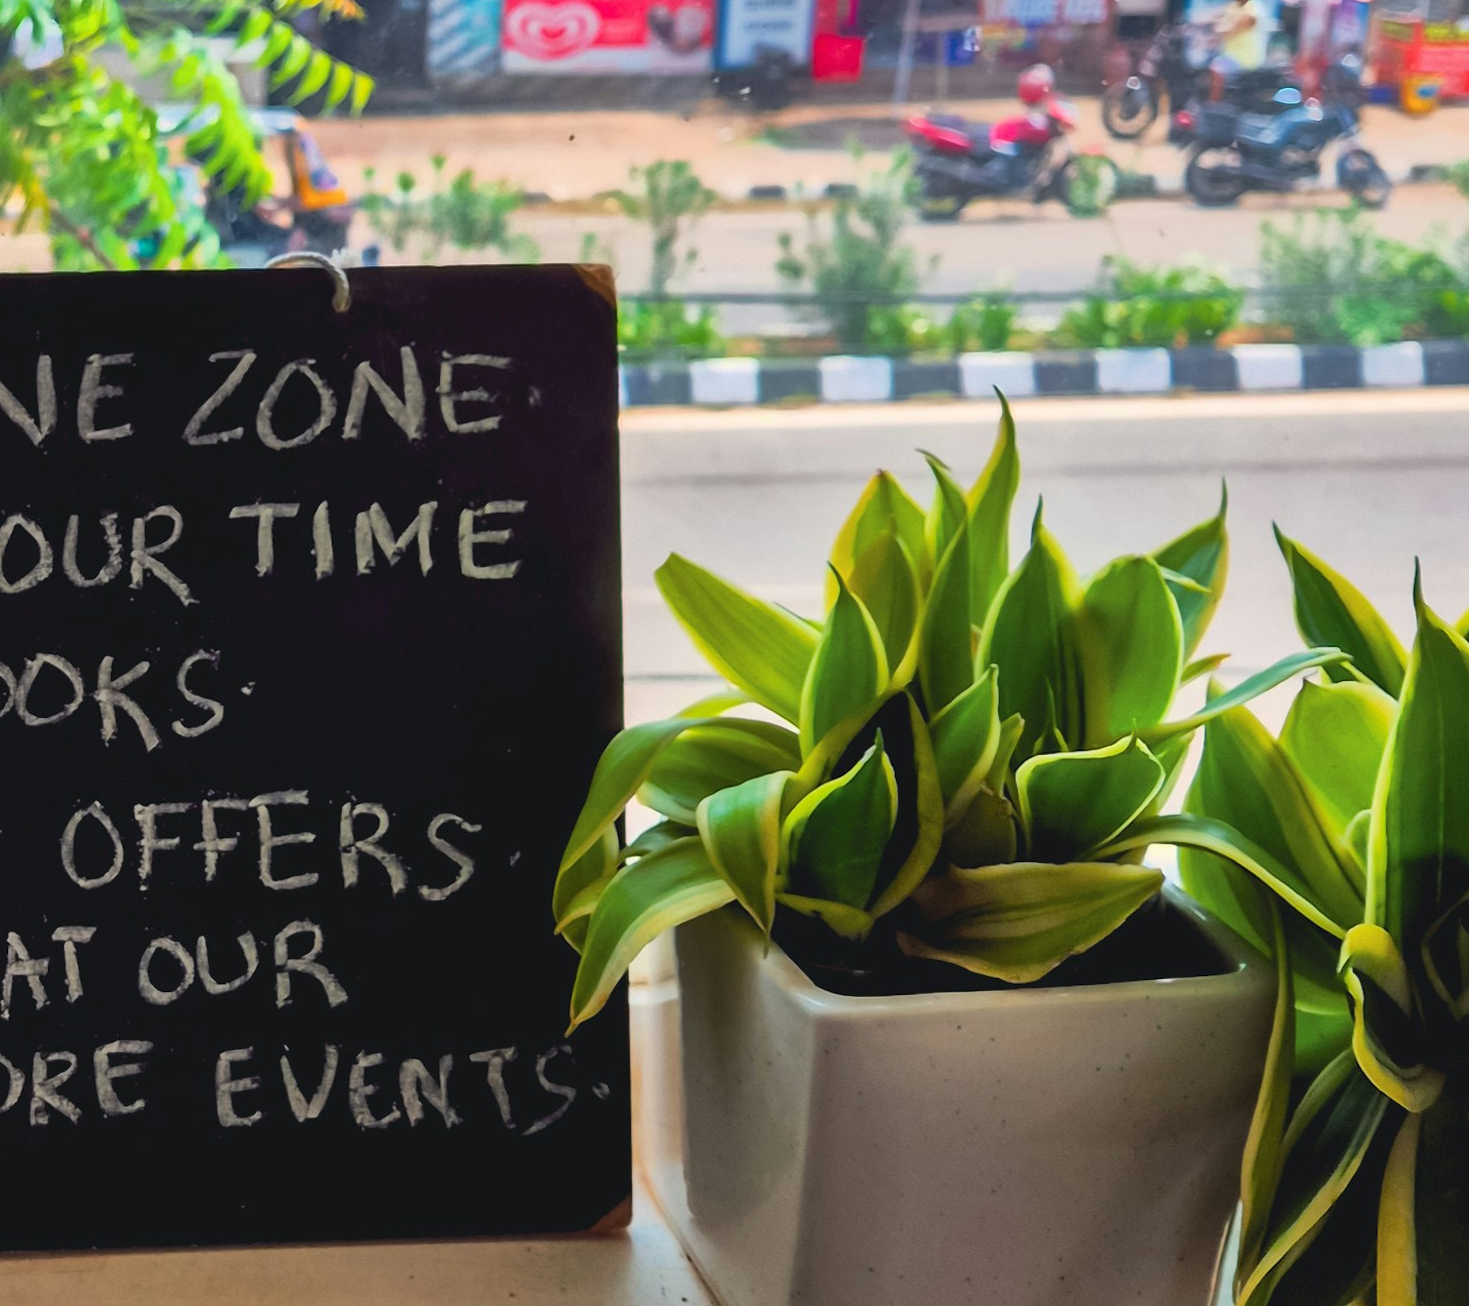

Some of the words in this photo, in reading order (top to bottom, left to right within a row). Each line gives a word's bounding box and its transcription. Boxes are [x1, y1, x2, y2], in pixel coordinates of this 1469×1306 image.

[229, 500, 526, 579] TIME
[0, 926, 96, 1019] AT
[139, 921, 348, 1008] OUR
